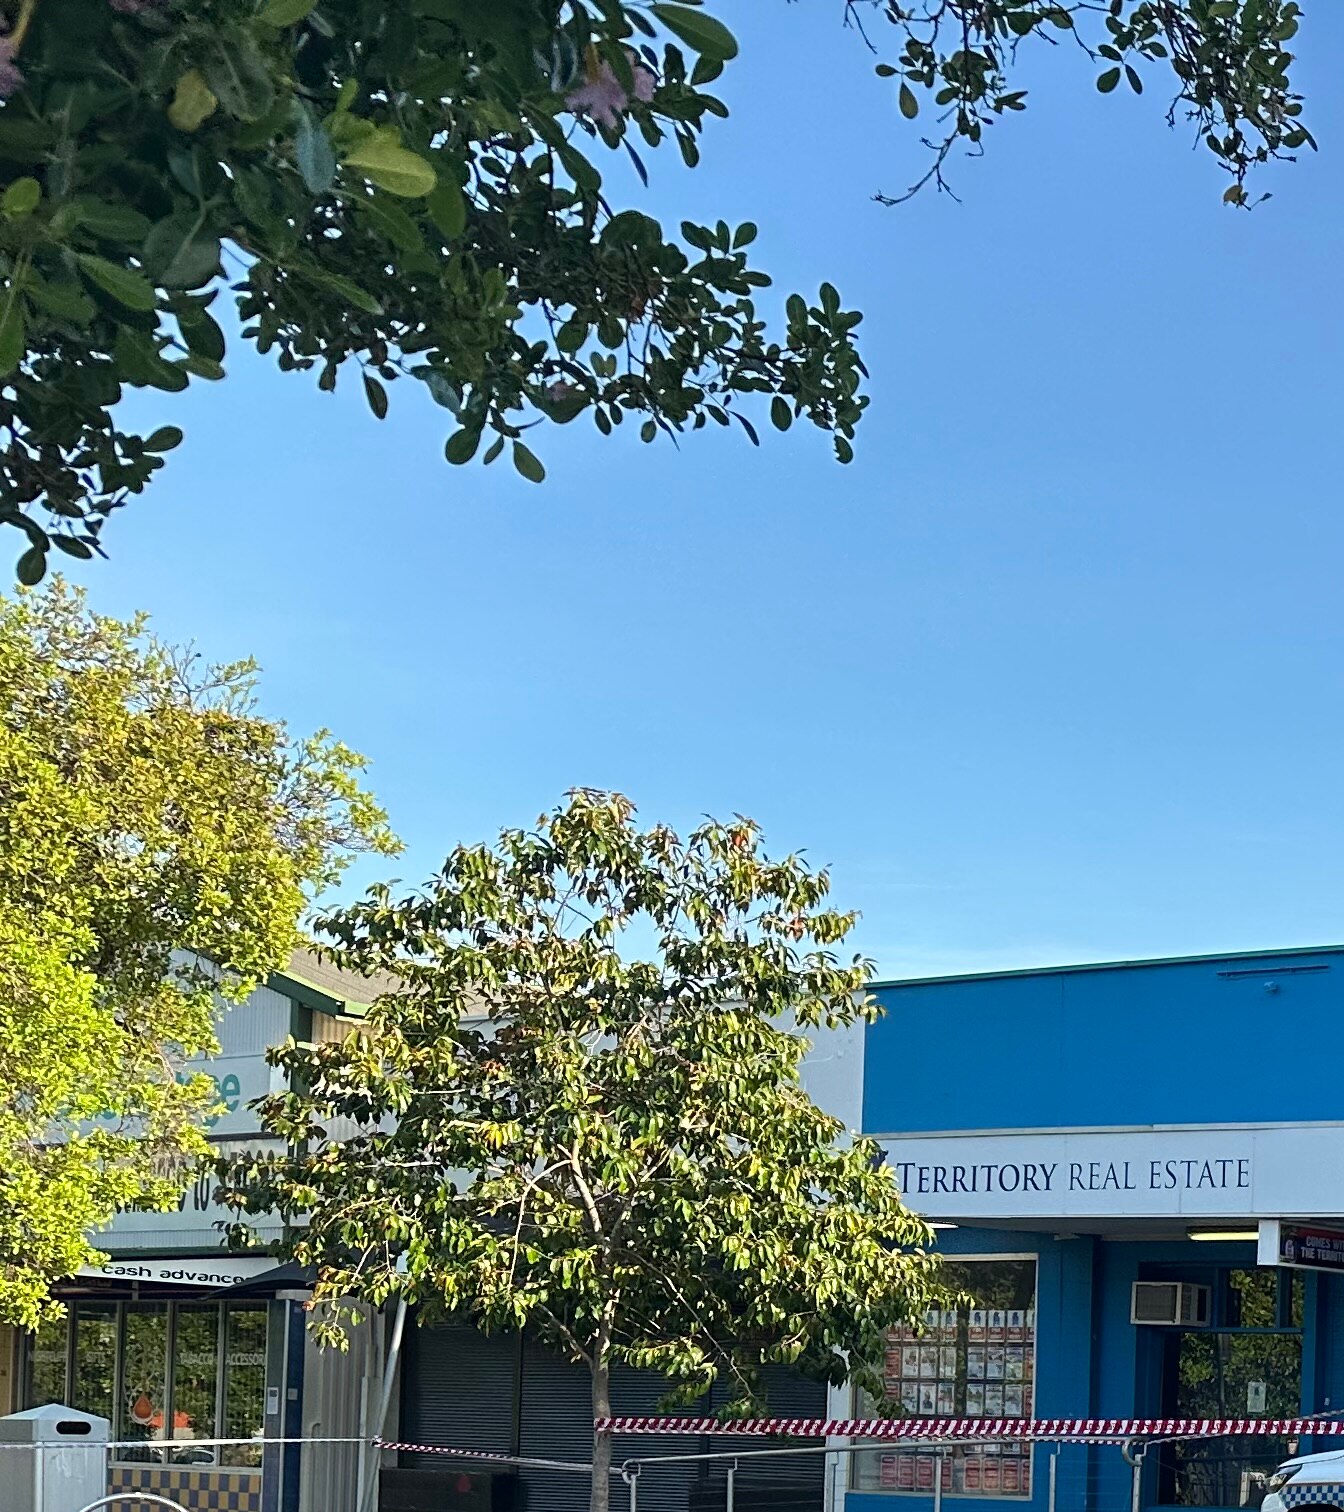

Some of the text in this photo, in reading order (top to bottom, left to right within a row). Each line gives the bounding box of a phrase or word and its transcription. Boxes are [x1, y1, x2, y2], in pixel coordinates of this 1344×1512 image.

[897, 1158, 1251, 1194] TERRITORY REAL ESTATE
[1306, 1235, 1331, 1249] COMES
[1301, 1247, 1315, 1259] THE
[101, 1265, 250, 1284] cash advance
